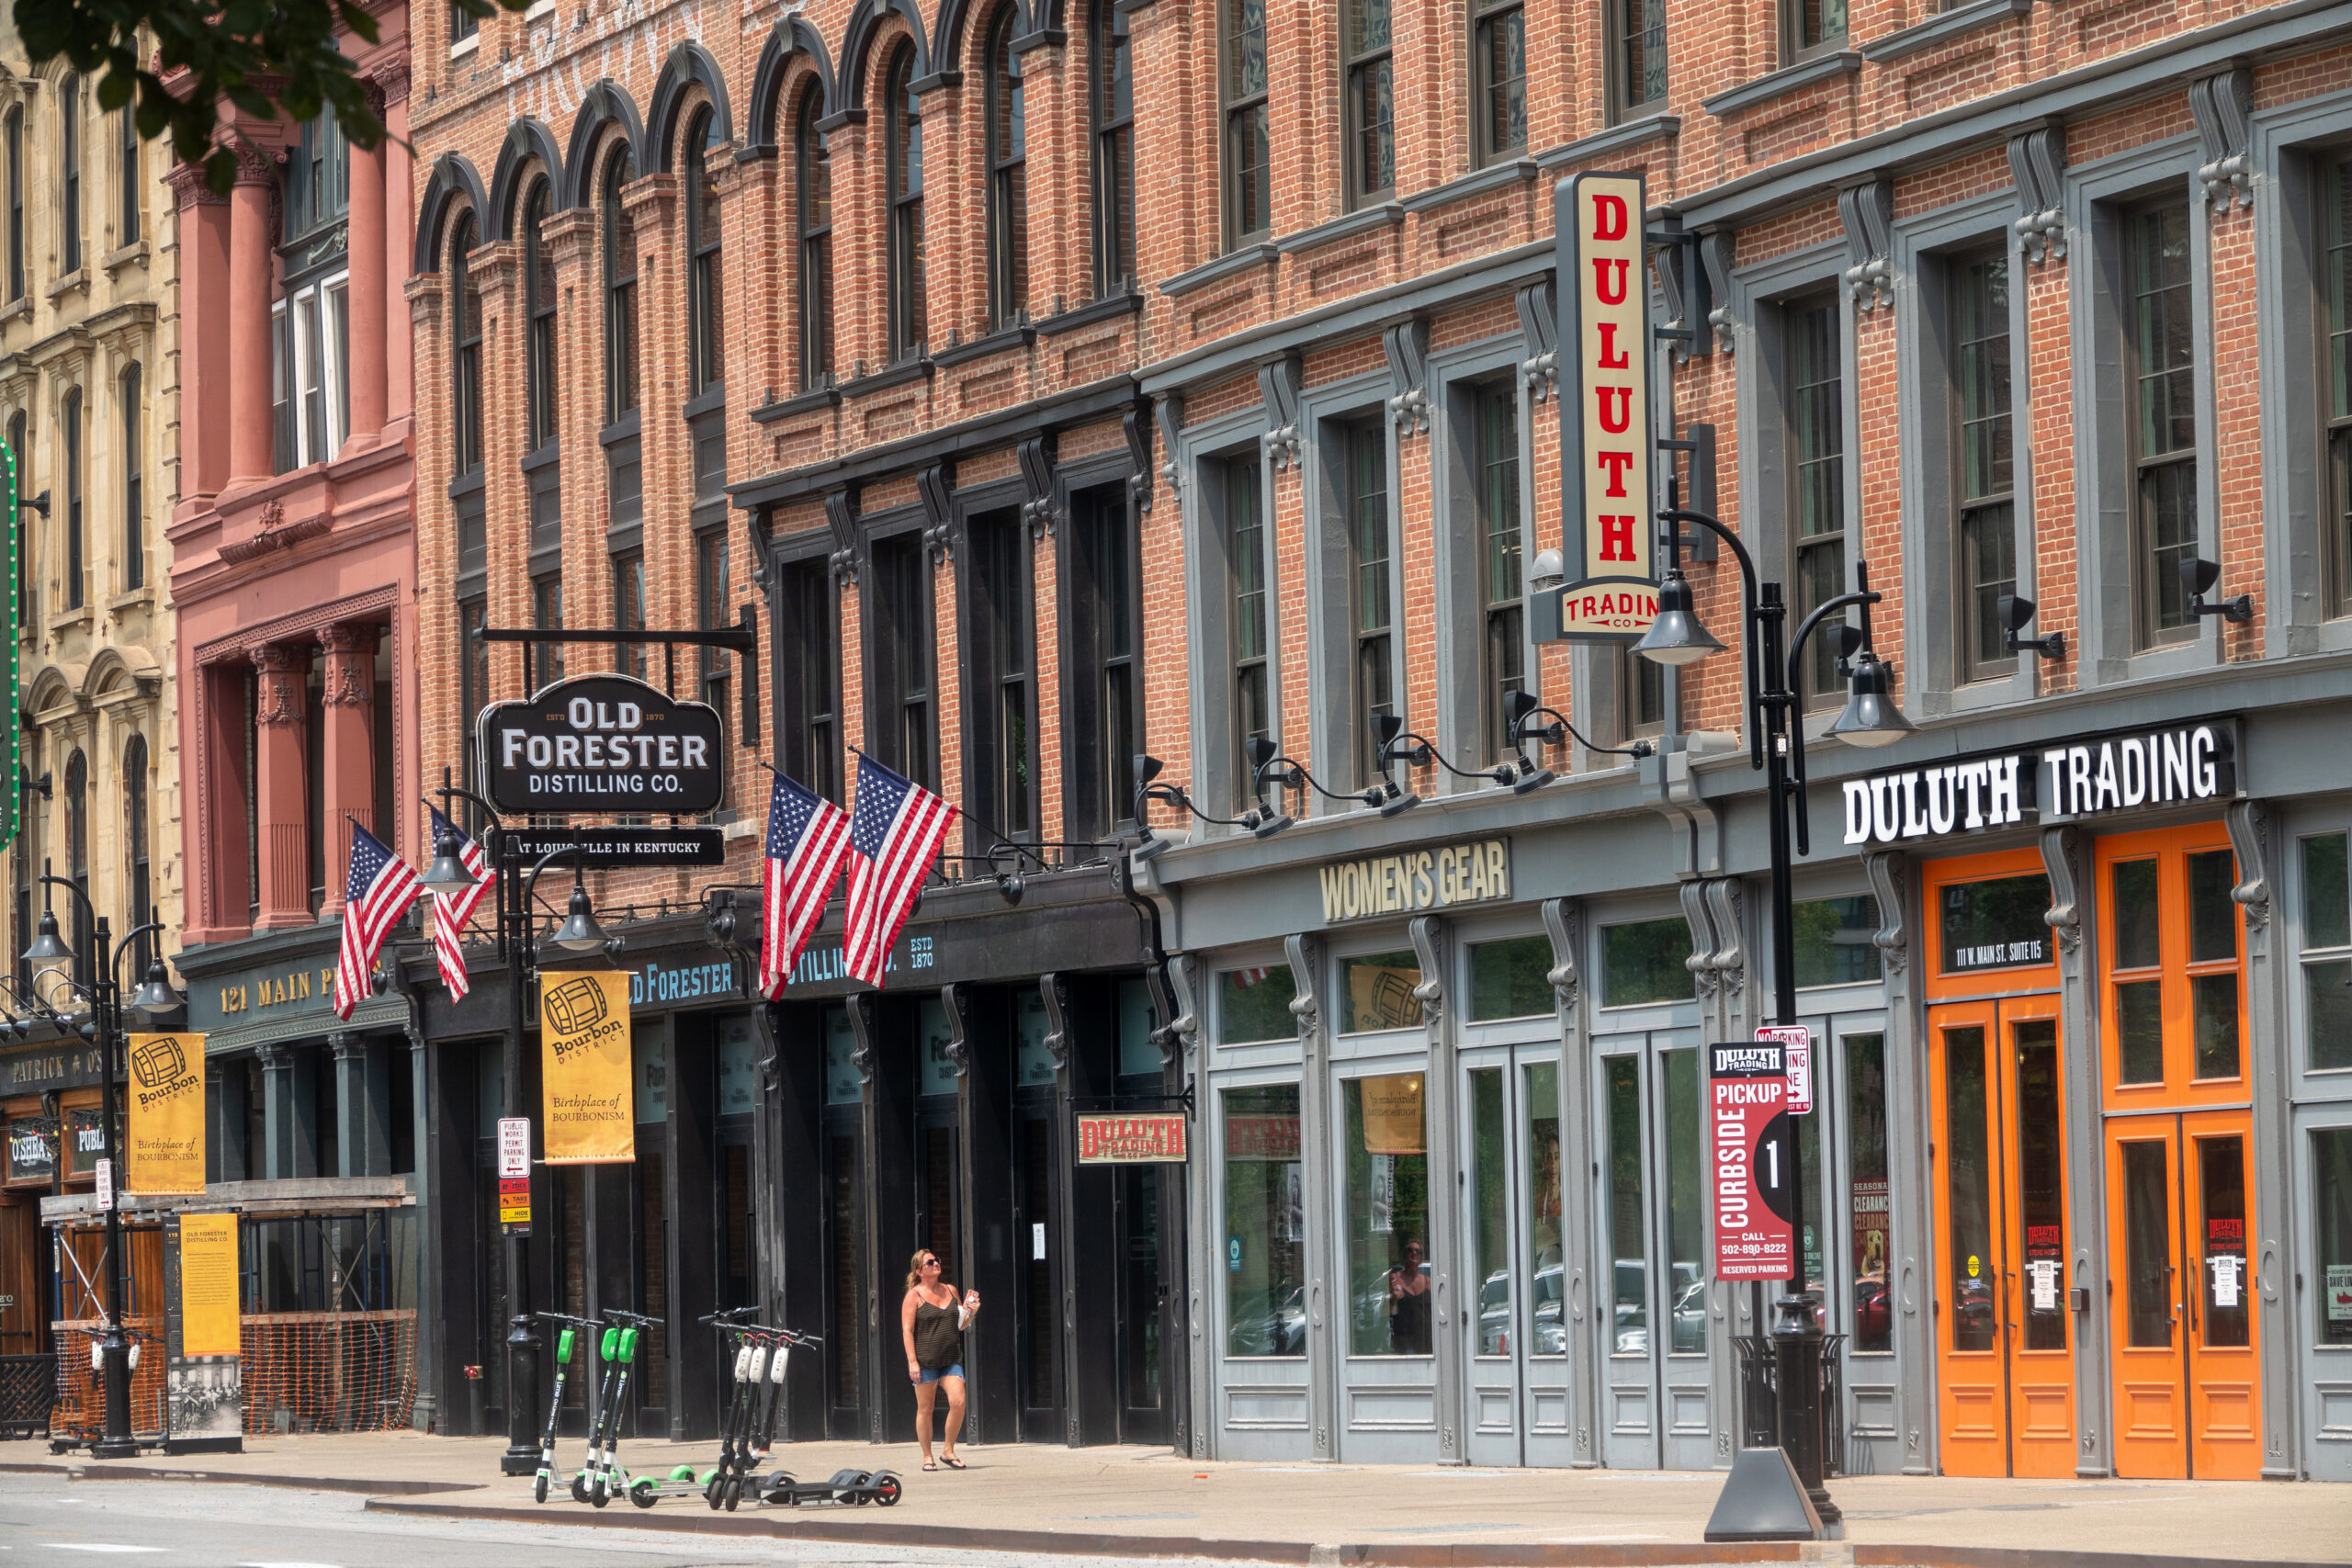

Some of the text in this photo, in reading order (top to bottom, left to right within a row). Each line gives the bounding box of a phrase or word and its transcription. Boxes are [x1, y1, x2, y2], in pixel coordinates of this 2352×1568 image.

[1591, 194, 1636, 561] DULUTH
[1566, 593, 1660, 622] TRADIN
[1613, 618, 1631, 628] CO
[568, 697, 642, 731] OLD
[502, 728, 709, 770] FORESTER
[529, 774, 684, 794] DISTILLING CO.
[1842, 727, 2217, 845] DULUTH TRADING
[616, 842, 630, 853] IN
[635, 842, 701, 853] KENTUCKY
[1319, 840, 1510, 920] WOMEN'S GEAR
[910, 937, 933, 952] ESTD
[1956, 940, 2041, 967] 111 W. MAIN ST. SUITE 115
[910, 953, 933, 969] 1870
[647, 963, 731, 1002] FORESTER
[220, 984, 248, 1014] 121
[258, 972, 311, 1007] MAIN
[552, 1020, 623, 1055] Bourbon
[558, 1030, 627, 1065] DISTRICT
[1773, 1032, 1805, 1046] PARKING
[13, 1055, 64, 1084] PATRICK
[1715, 1048, 1781, 1072] DULUTH
[1728, 1059, 1769, 1071] TRADING
[138, 1074, 198, 1105] Bourbon
[142, 1083, 200, 1113] DISTRICT
[1716, 1083, 1781, 1105] PICKUP
[553, 1093, 621, 1111] Birthplace of
[504, 1122, 524, 1131] PUBLIC
[552, 1111, 625, 1122] BOURBONISM
[79, 1129, 105, 1152] PUBLI
[138, 1137, 197, 1153] Birthplace of
[1080, 1118, 1184, 1157] DULUTH
[137, 1153, 198, 1161] BOURBONISM
[504, 1148, 525, 1156] PARKING
[1101, 1139, 1164, 1157] TRADING
[1717, 1108, 1749, 1229] CURBSIDE
[1767, 1140, 1779, 1189] 1
[1853, 1181, 1889, 1190] SEASONA
[1854, 1195, 1889, 1213] CLEARANC
[1855, 1213, 1889, 1230] CLEARANC
[2209, 1219, 2242, 1239] DULUTH
[1741, 1232, 1766, 1241] CALL
[2028, 1225, 2059, 1246] DULUTH
[1722, 1243, 1786, 1255] 502-890-8222
[1722, 1265, 1788, 1275] RESERVED PARKING
